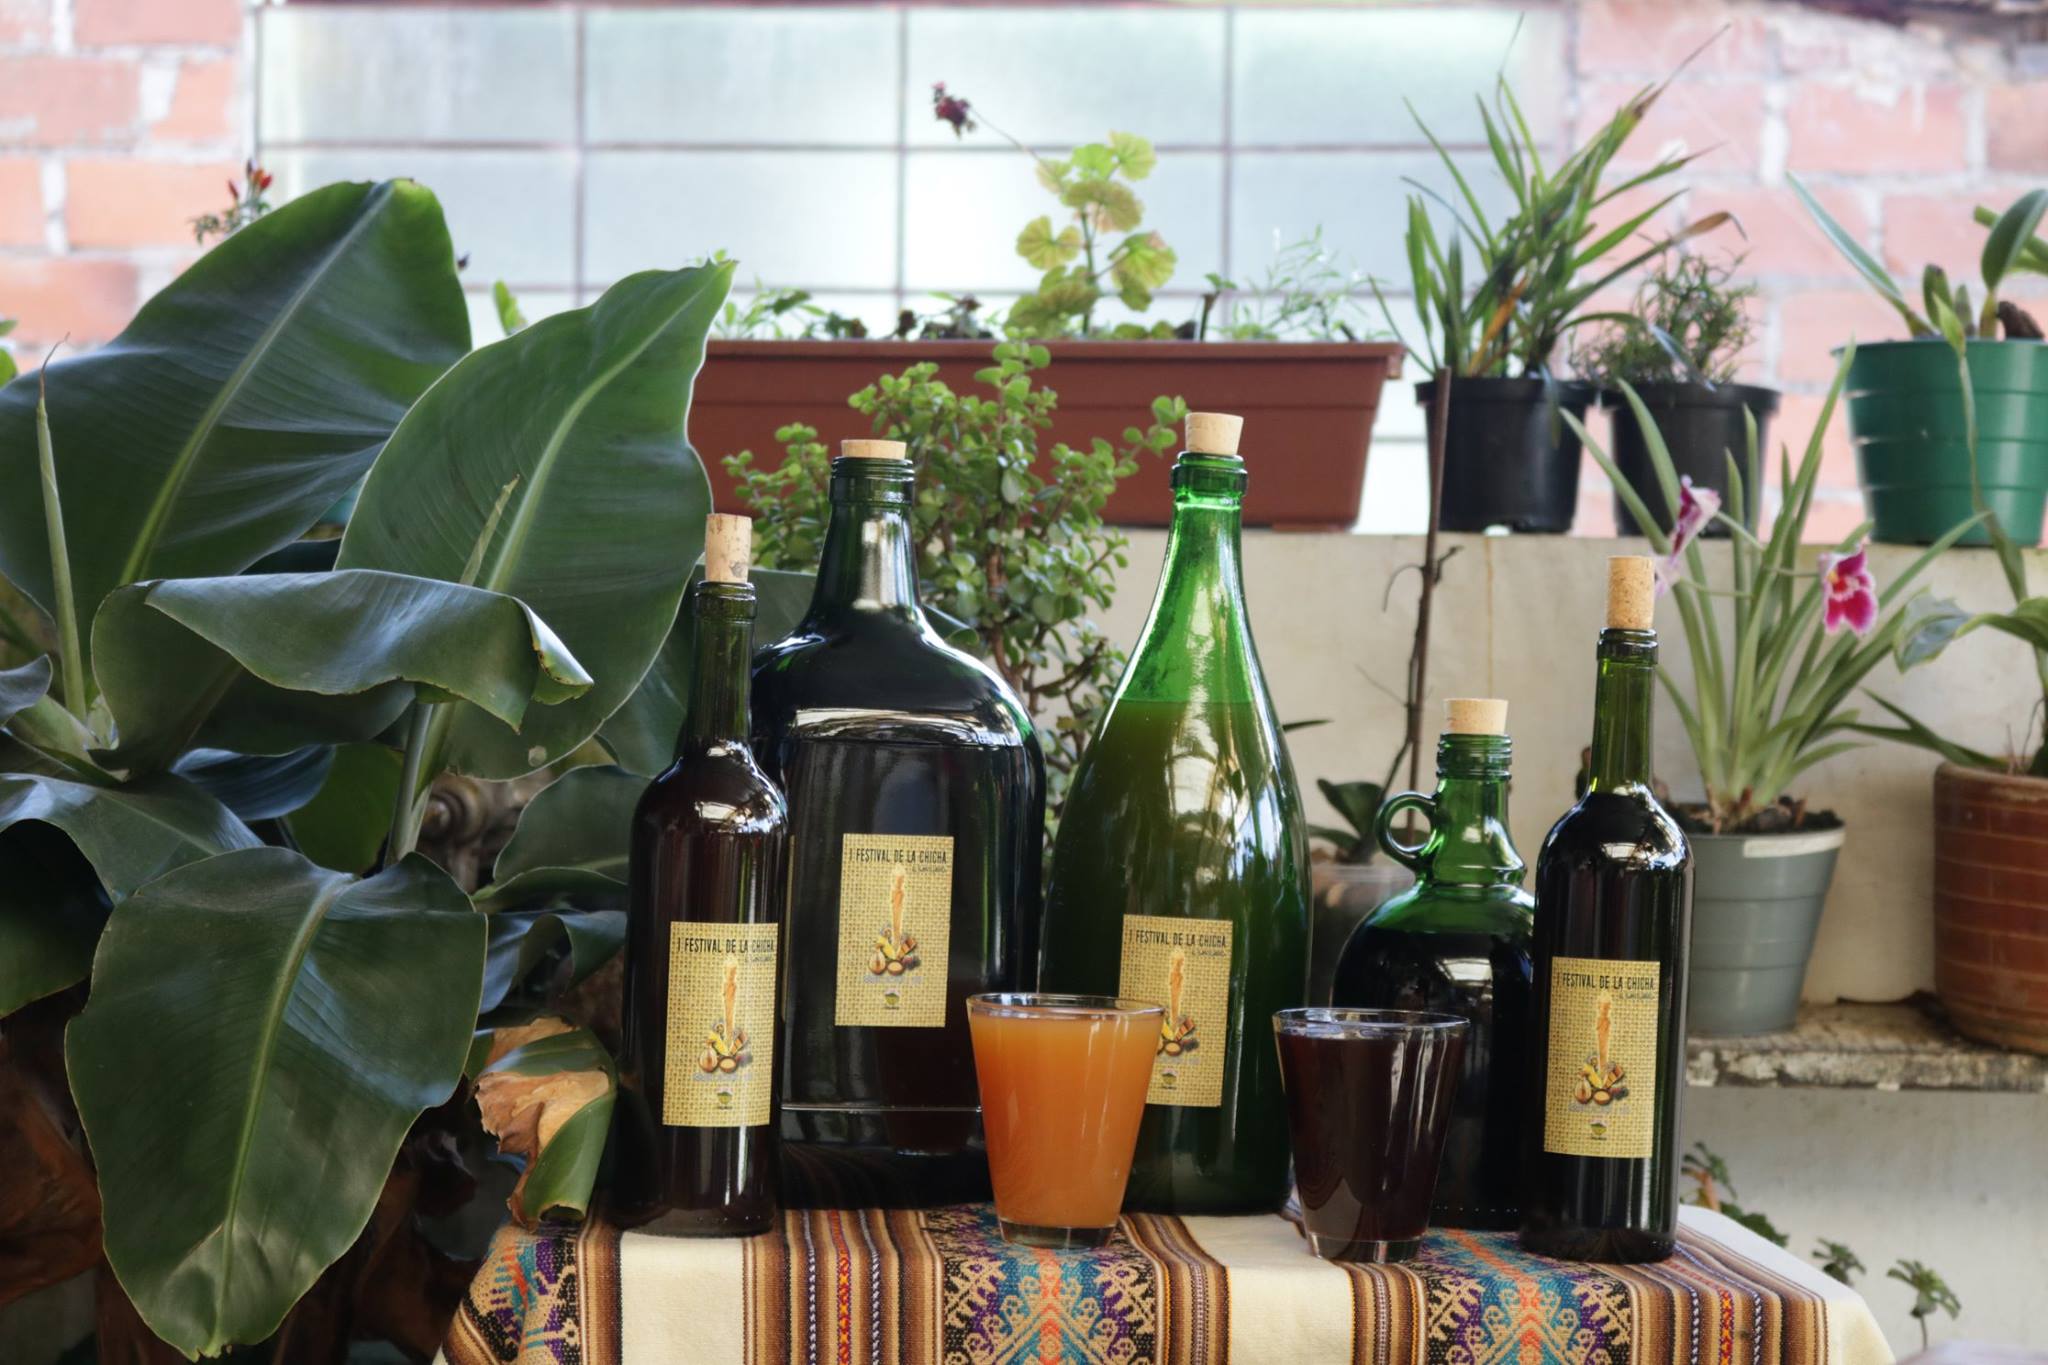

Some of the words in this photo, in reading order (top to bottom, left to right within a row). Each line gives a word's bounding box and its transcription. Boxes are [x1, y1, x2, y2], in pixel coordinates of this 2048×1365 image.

[856, 848, 890, 863] FESTIVAL
[894, 849, 904, 863] DE
[907, 850, 916, 864] LA
[920, 850, 947, 864] CHICHA
[684, 938, 722, 953] FESTIVAL
[725, 939, 736, 953] DE
[739, 939, 749, 953] LA
[1136, 929, 1170, 945] FESTIVAL
[1173, 931, 1183, 946] DE
[1186, 933, 1196, 947] LA
[1199, 934, 1226, 948] CHICHA
[1562, 972, 1596, 989] FESTIVAL
[1599, 975, 1610, 989] DE
[1613, 975, 1623, 990] LA
[1627, 976, 1654, 991] CHICHA
